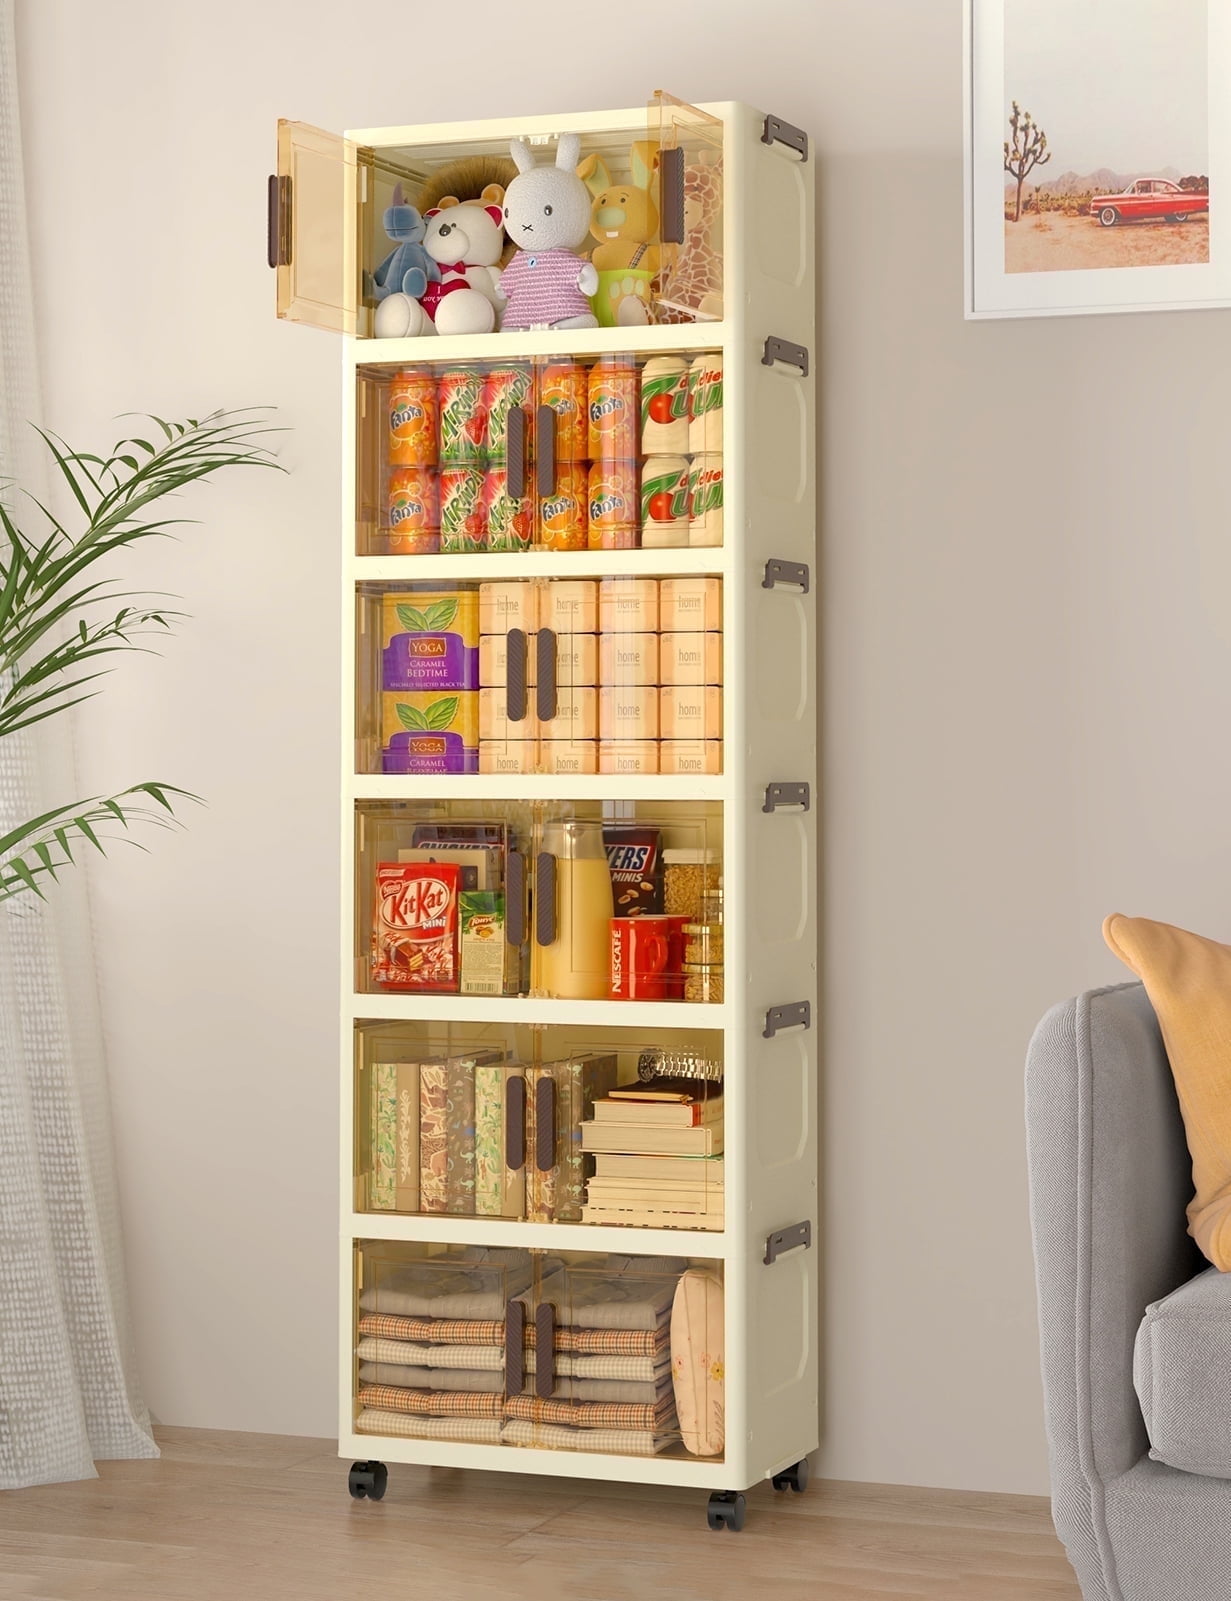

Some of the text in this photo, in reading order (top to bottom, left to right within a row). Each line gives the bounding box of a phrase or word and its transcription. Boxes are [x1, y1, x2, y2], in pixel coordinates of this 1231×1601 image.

[617, 595, 640, 609] home
[411, 642, 443, 653] YOGA
[617, 649, 640, 663] home
[409, 660, 446, 668] CARAMEL
[407, 668, 449, 678] BEDTIME
[617, 703, 640, 716] home
[409, 759, 446, 767] CARAMEL
[496, 756, 519, 769] home
[556, 756, 579, 769] home
[617, 756, 640, 769] home
[678, 756, 702, 769] home
[612, 872, 644, 883] MINIS
